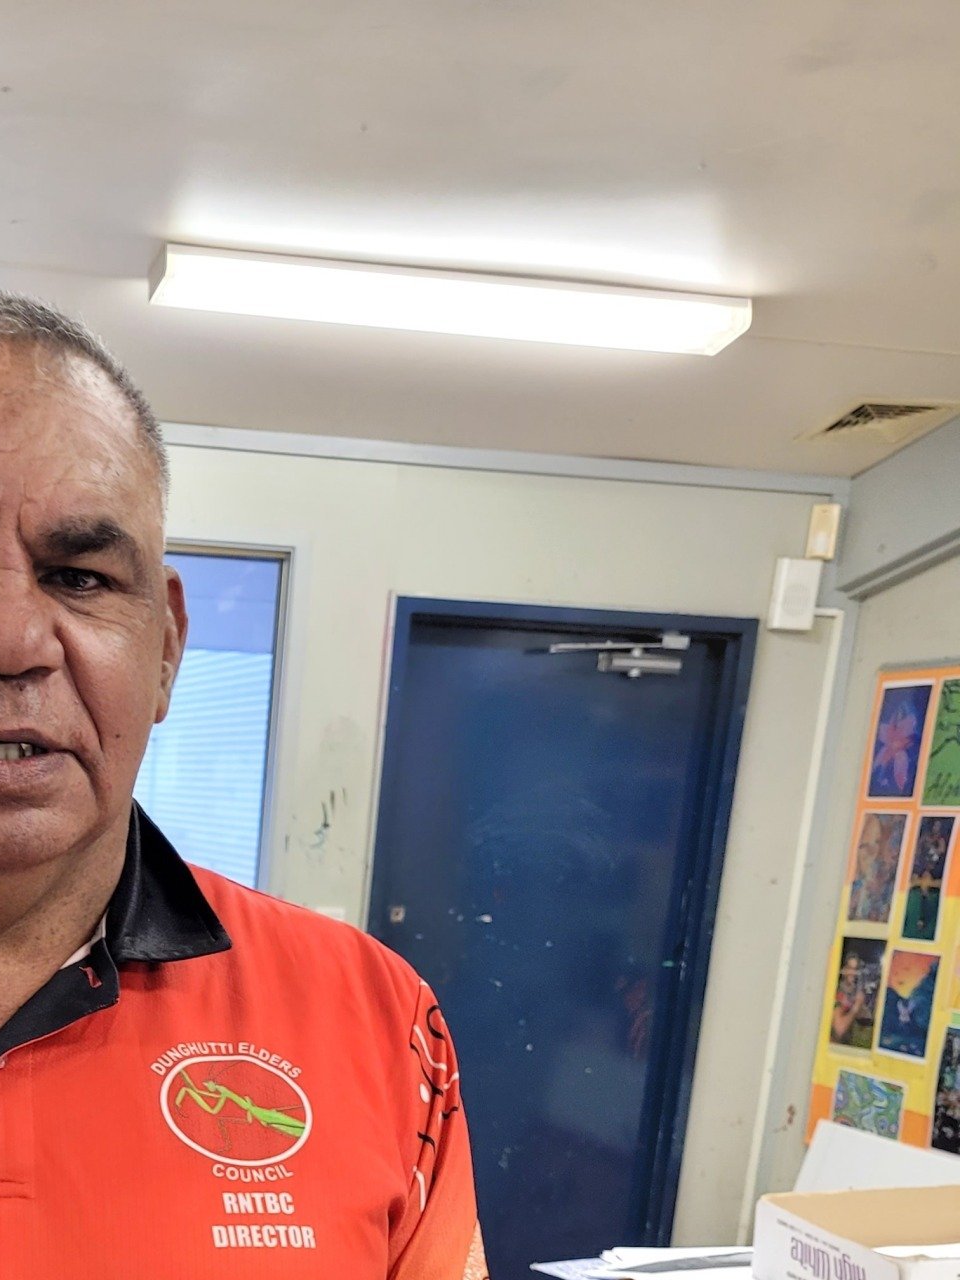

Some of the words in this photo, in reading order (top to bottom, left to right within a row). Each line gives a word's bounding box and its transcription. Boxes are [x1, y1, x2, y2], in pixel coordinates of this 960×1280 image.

[150, 1041, 234, 1076] DUNGHUTTI
[238, 1042, 302, 1079] ELDERS
[212, 1164, 294, 1183] COUNCIL
[222, 1192, 295, 1215] RNTBC
[211, 1225, 317, 1249] DIRECTOR
